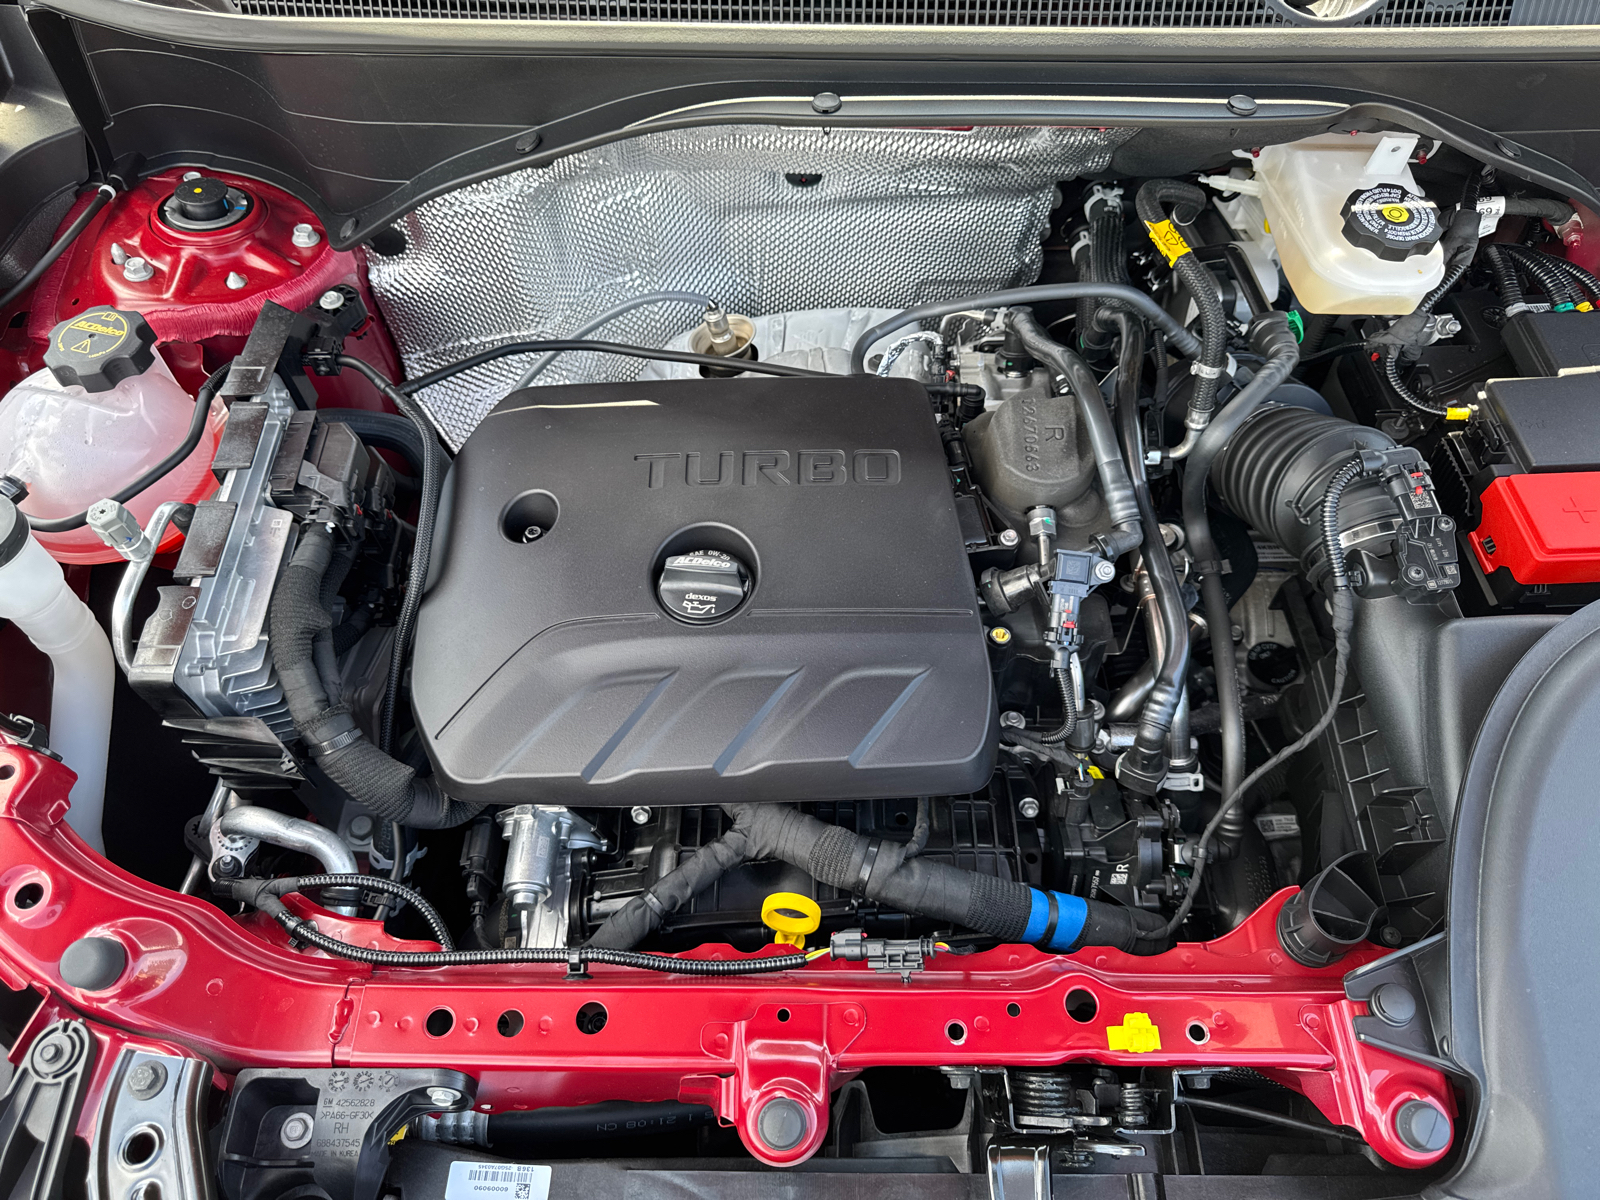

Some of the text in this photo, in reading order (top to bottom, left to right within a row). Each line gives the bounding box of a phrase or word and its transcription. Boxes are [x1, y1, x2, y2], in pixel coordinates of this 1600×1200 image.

[74, 321, 125, 336] ACDelco
[1044, 424, 1064, 441] R
[634, 449, 900, 488] TURBO
[672, 557, 731, 568] ACDelco
[685, 593, 718, 601] dexos
[1116, 864, 1129, 872] R
[334, 1122, 349, 1134] RH
[597, 1122, 617, 1131] CN
[317, 1139, 360, 1147] 688437545
